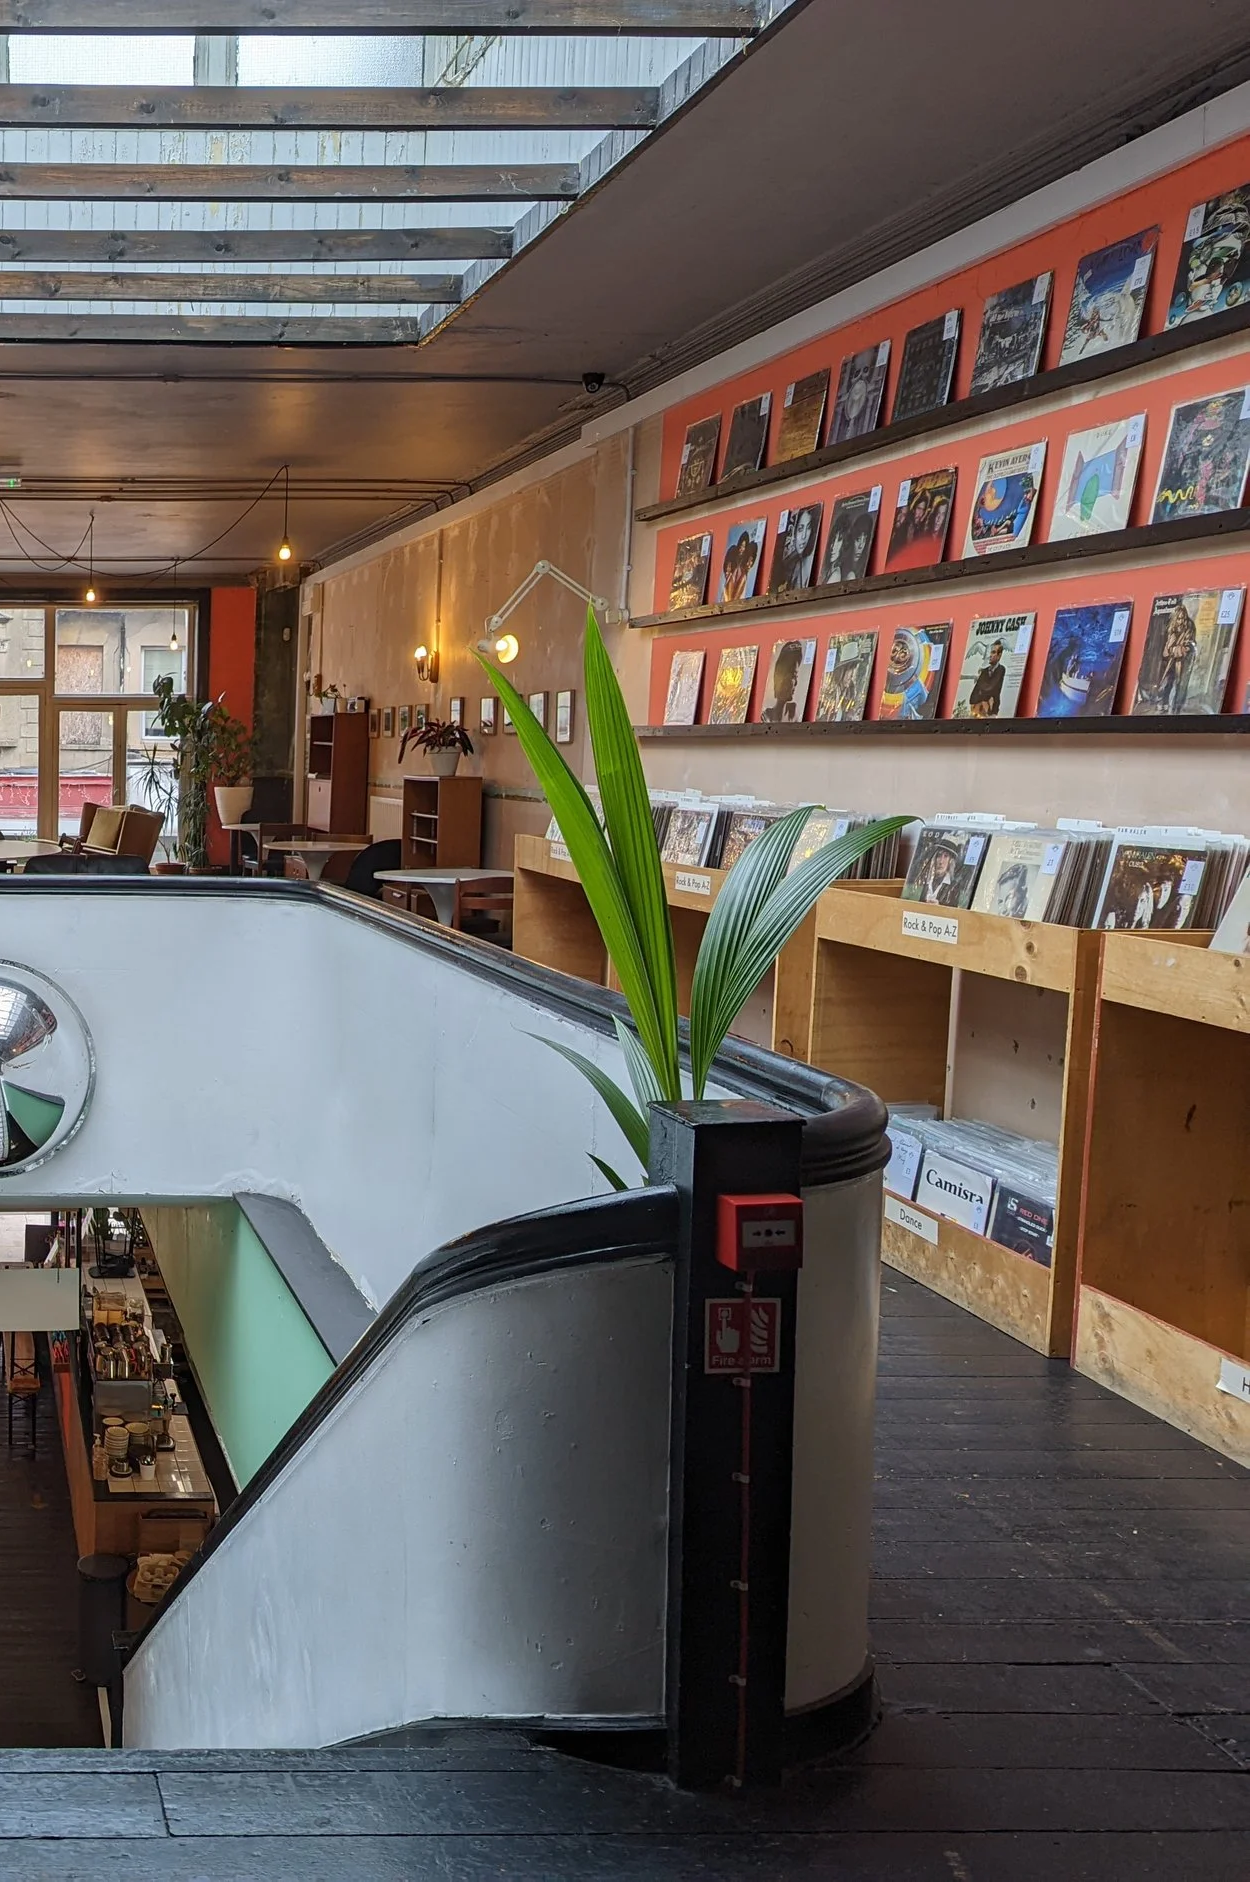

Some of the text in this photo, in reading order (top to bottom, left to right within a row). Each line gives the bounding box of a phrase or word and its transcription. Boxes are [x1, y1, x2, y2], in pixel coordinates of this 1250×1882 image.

[988, 458, 1009, 473] KEVIN
[975, 616, 1028, 636] JOHNNY CASH
[676, 875, 687, 886] Rock
[692, 878, 701, 890] Pop
[701, 880, 711, 890] A-Z
[904, 917, 958, 938] Rock & Pop A-Z
[926, 1168, 984, 1205] Camisra
[900, 1208, 923, 1231] Dance
[712, 1355, 735, 1366] Fire
